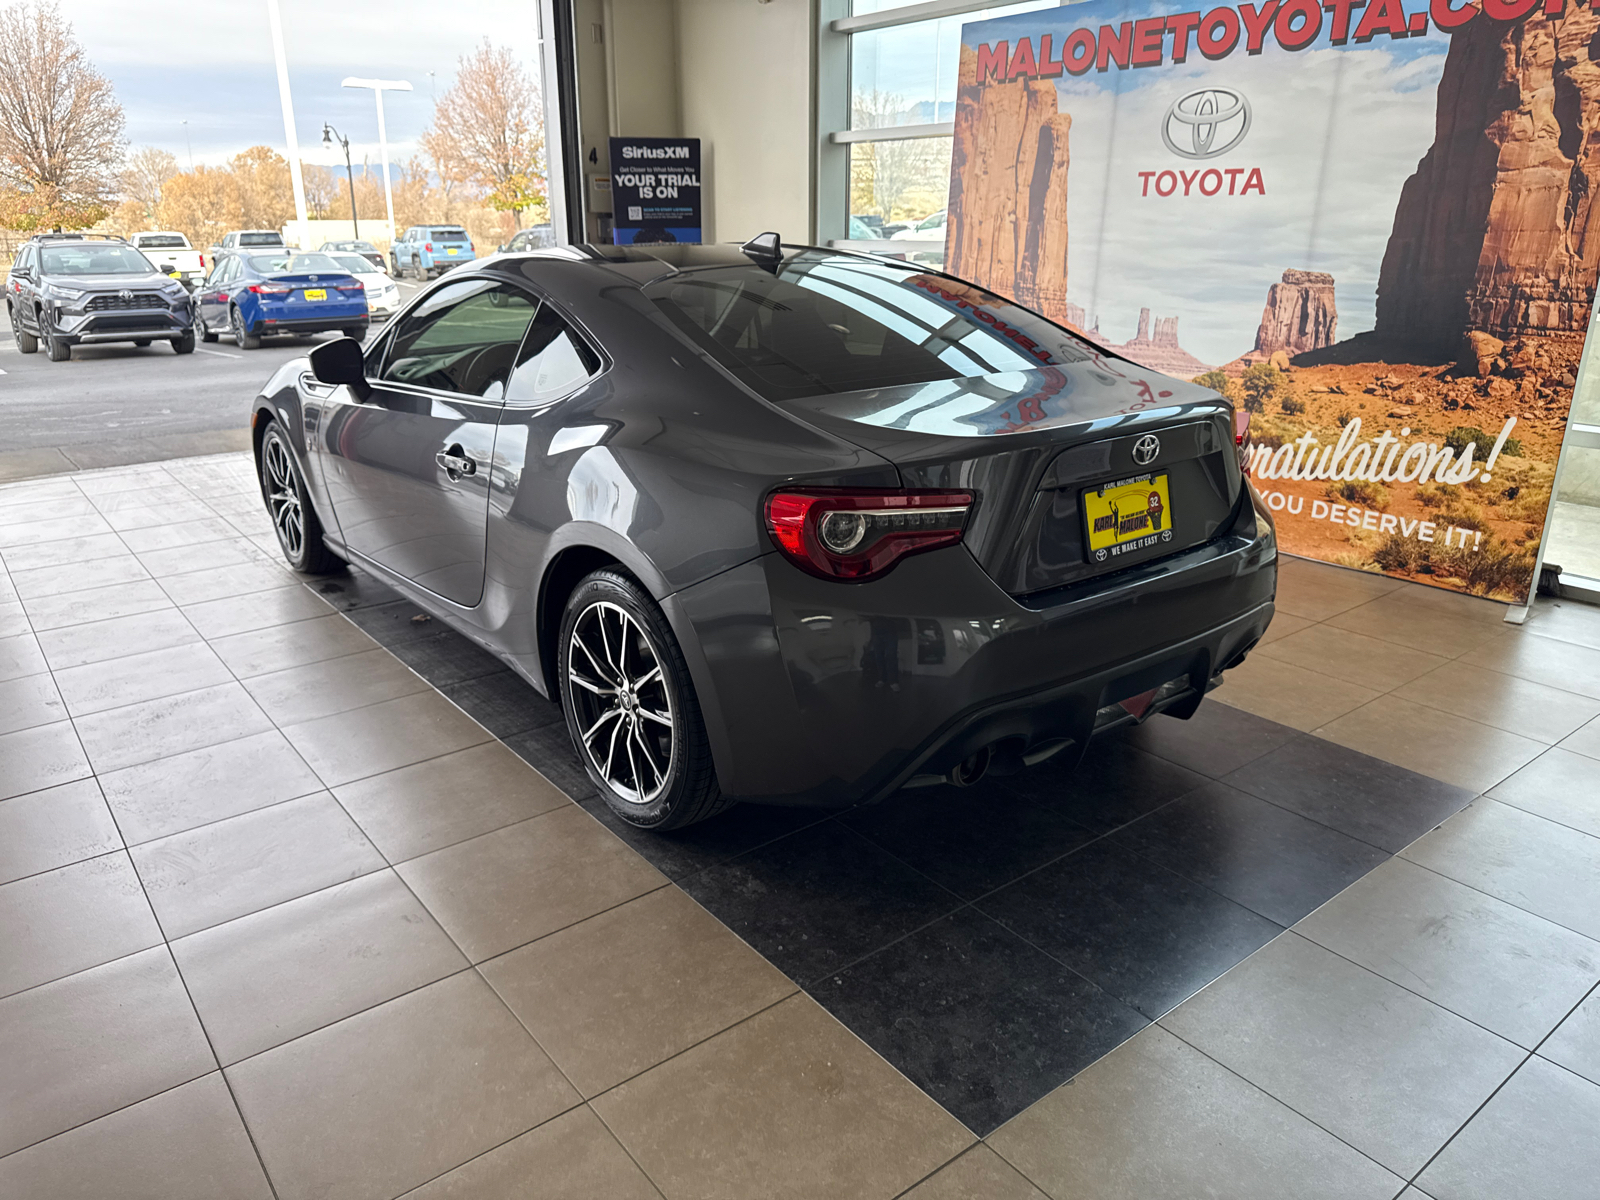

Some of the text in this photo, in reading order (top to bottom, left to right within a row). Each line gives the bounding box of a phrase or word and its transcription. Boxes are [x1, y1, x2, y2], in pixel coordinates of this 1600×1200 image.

[589, 146, 598, 165] 4
[622, 146, 689, 159] SiriusXM
[615, 174, 700, 187] YOUR TRIAL
[1137, 167, 1267, 197] TOYOTA
[639, 187, 678, 199] IS ON
[1249, 417, 1517, 484] ratulations!
[1149, 496, 1159, 507] 32
[1093, 514, 1115, 534] KARL
[1118, 515, 1149, 535] MALONE
[1311, 499, 1436, 543] DESERVE
[1444, 525, 1483, 551] IT!
[1111, 535, 1158, 556] WE MAKE IT EASY
